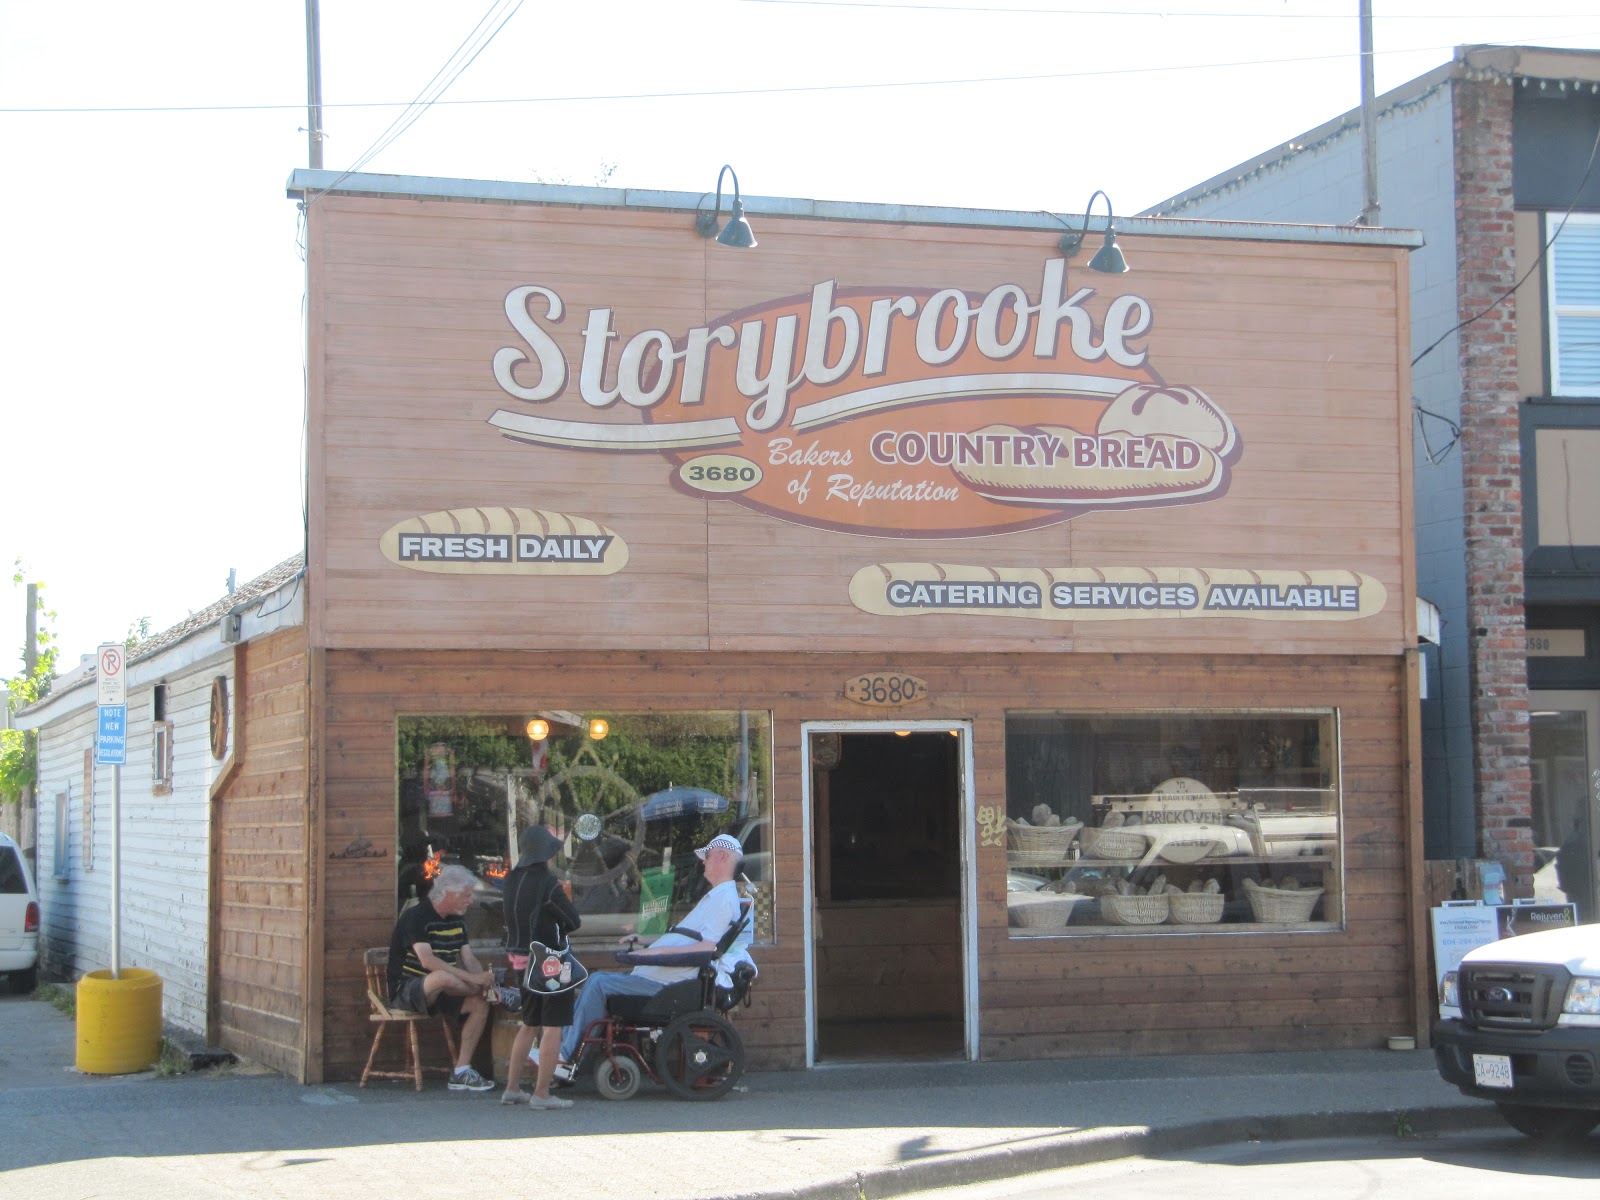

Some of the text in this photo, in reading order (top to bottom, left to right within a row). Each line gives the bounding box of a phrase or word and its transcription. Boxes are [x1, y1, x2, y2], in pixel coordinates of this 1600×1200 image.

[492, 257, 1152, 431] Storybrooke
[767, 437, 853, 467] Bakers
[869, 430, 1202, 471] COUNTRY BREAD
[688, 465, 756, 482] 3680
[787, 470, 959, 508] of Reputation
[402, 537, 606, 559] FRESH DAILY
[889, 584, 1356, 608] CATERING SERVICES AVAILABLE
[858, 677, 916, 703] 3680
[104, 708, 121, 717] NOTE
[105, 722, 119, 730] NEW
[100, 735, 124, 744] PARKING
[1145, 810, 1182, 824] BRICK
